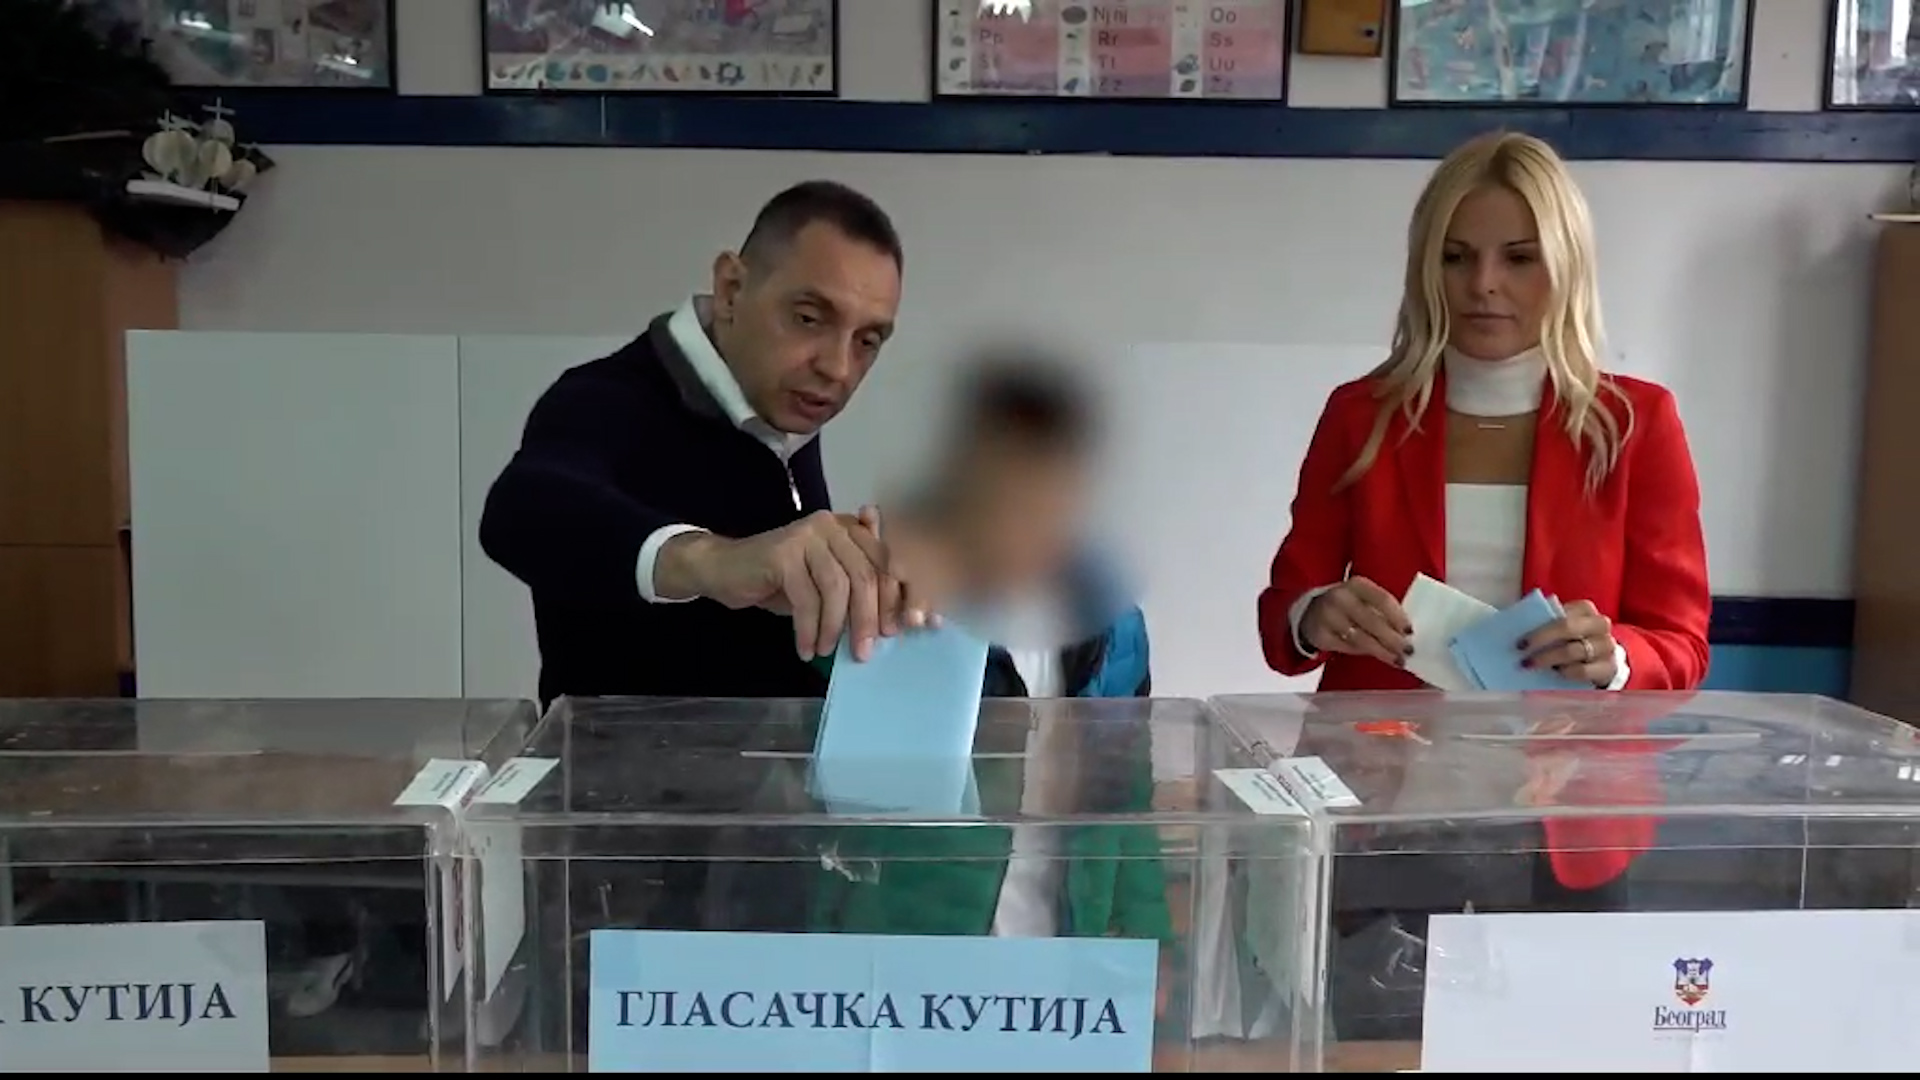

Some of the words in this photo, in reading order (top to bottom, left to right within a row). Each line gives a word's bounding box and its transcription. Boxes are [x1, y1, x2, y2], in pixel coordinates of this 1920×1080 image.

[1210, 7, 1237, 24] Oo
[980, 28, 1004, 46] Pp
[1098, 30, 1119, 47] Rr
[1210, 31, 1234, 48] Ss
[1209, 57, 1235, 72] Uu
[20, 983, 236, 1027] КУТИЈА
[616, 991, 905, 1028] ГЛАСАЧКА
[920, 993, 1126, 1040] КУТИЈА
[1653, 1005, 1727, 1033] Београд
